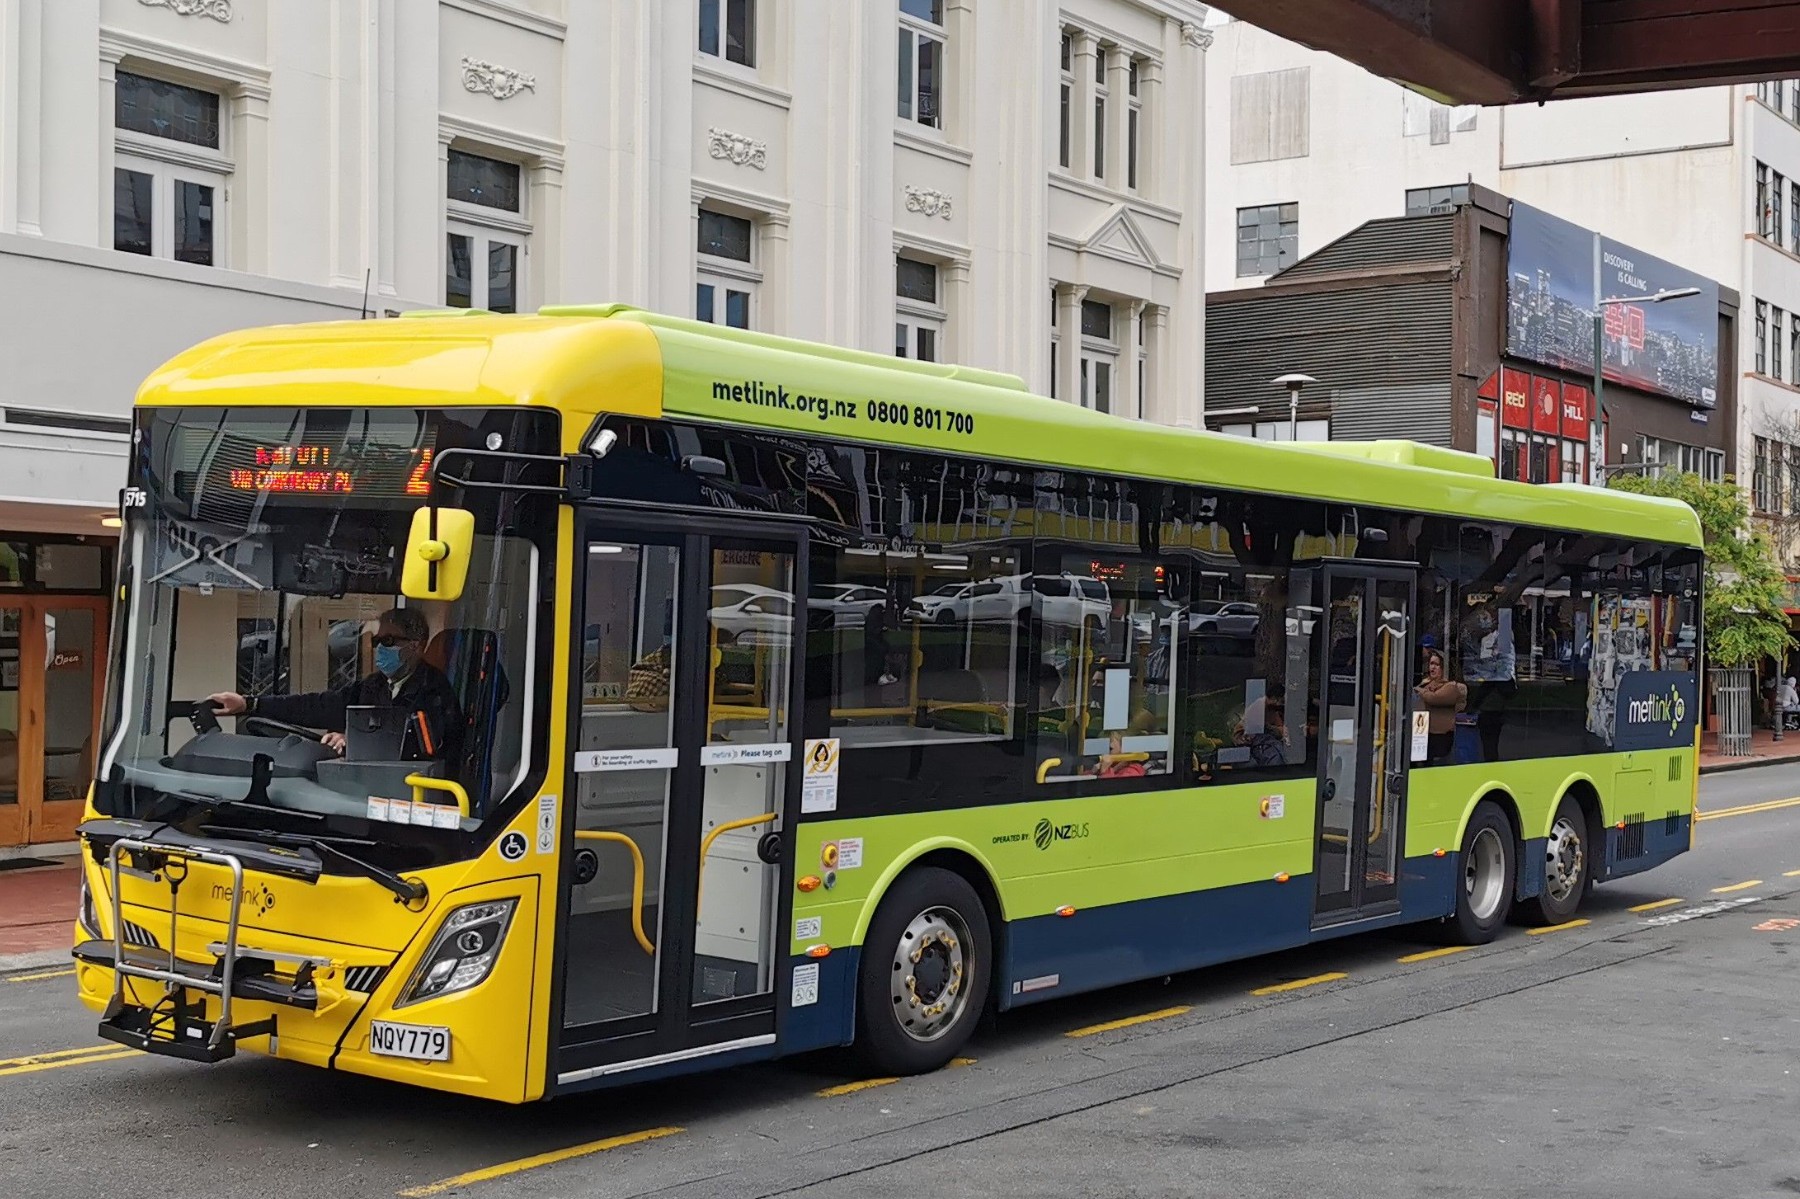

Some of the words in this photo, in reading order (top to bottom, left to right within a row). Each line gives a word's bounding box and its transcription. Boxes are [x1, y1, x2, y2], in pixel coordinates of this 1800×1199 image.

[1603, 251, 1634, 273] DISCOVERY
[1618, 271, 1624, 283] IS
[1624, 273, 1647, 292] CALLING
[713, 381, 857, 420] metlink.org.nz
[867, 399, 909, 426] 0800
[913, 406, 941, 430] 801
[946, 411, 974, 435] 700
[1563, 403, 1584, 421] HILL
[405, 448, 433, 494] 2
[125, 491, 147, 507] 5715
[54, 653, 79, 666] Open
[1628, 693, 1672, 723] metlink
[740, 749, 761, 757] Please
[762, 749, 773, 758] tag
[992, 834, 1021, 844] OPERATED
[211, 884, 260, 906] meink
[371, 1025, 445, 1055] NQY779
